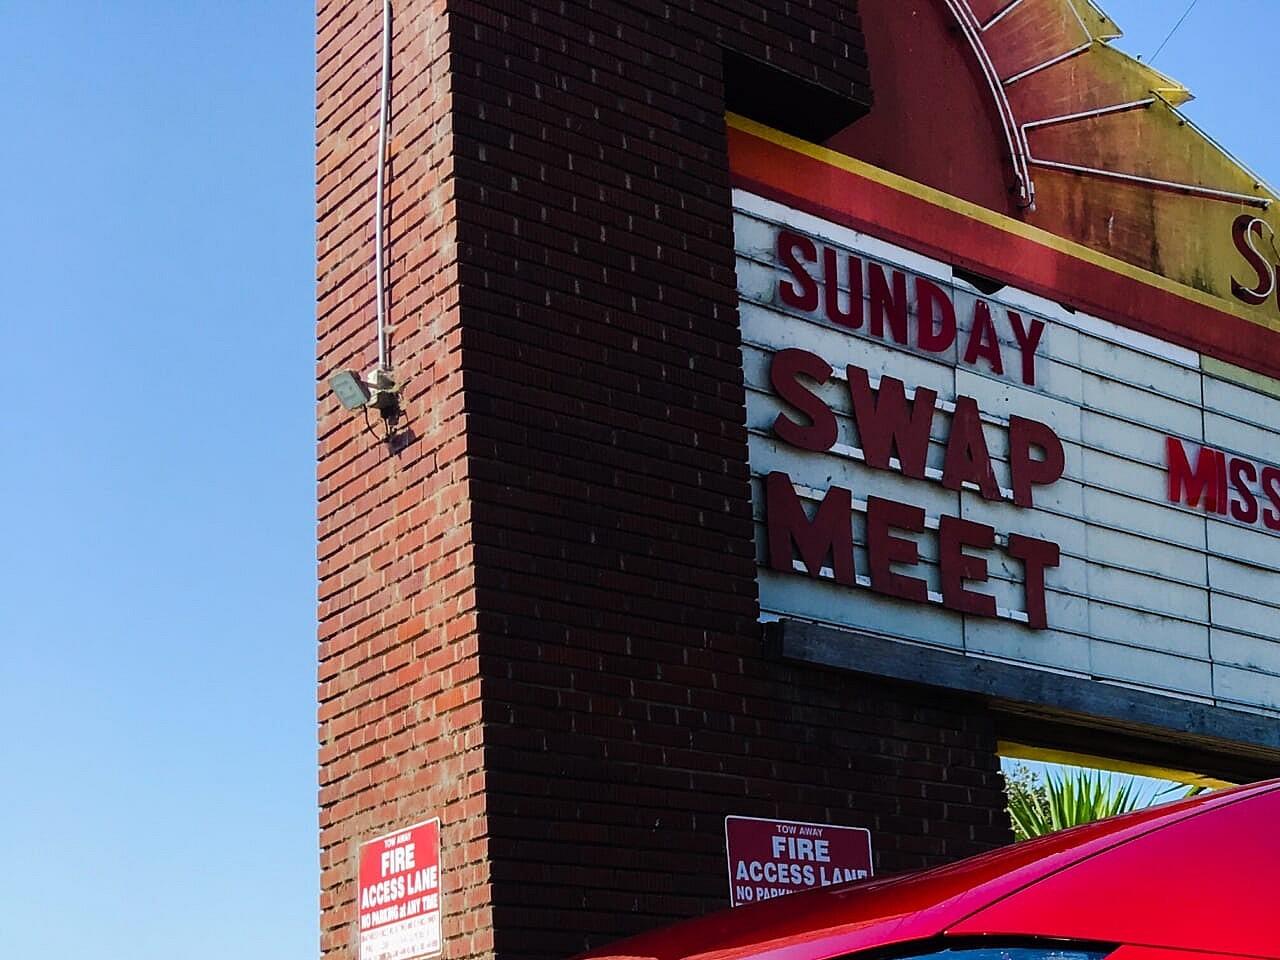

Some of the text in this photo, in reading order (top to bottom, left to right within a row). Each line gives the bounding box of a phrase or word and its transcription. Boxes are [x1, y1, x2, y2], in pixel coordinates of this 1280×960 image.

[778, 231, 1044, 386] SUNDAY
[770, 348, 1065, 508] SWAP
[767, 471, 1060, 629] MEET
[384, 837, 396, 849] TOW
[776, 825, 823, 837] TOW AWAY
[381, 843, 415, 878] FIRE
[772, 836, 830, 862] FIRE
[361, 865, 438, 909] ACCESS LANE
[736, 860, 815, 886] ACCESS
[361, 913, 371, 929] NO
[371, 905, 399, 926] PARKING
[407, 898, 421, 916] ANY
[422, 893, 438, 911] TIME
[736, 886, 753, 901] NO
